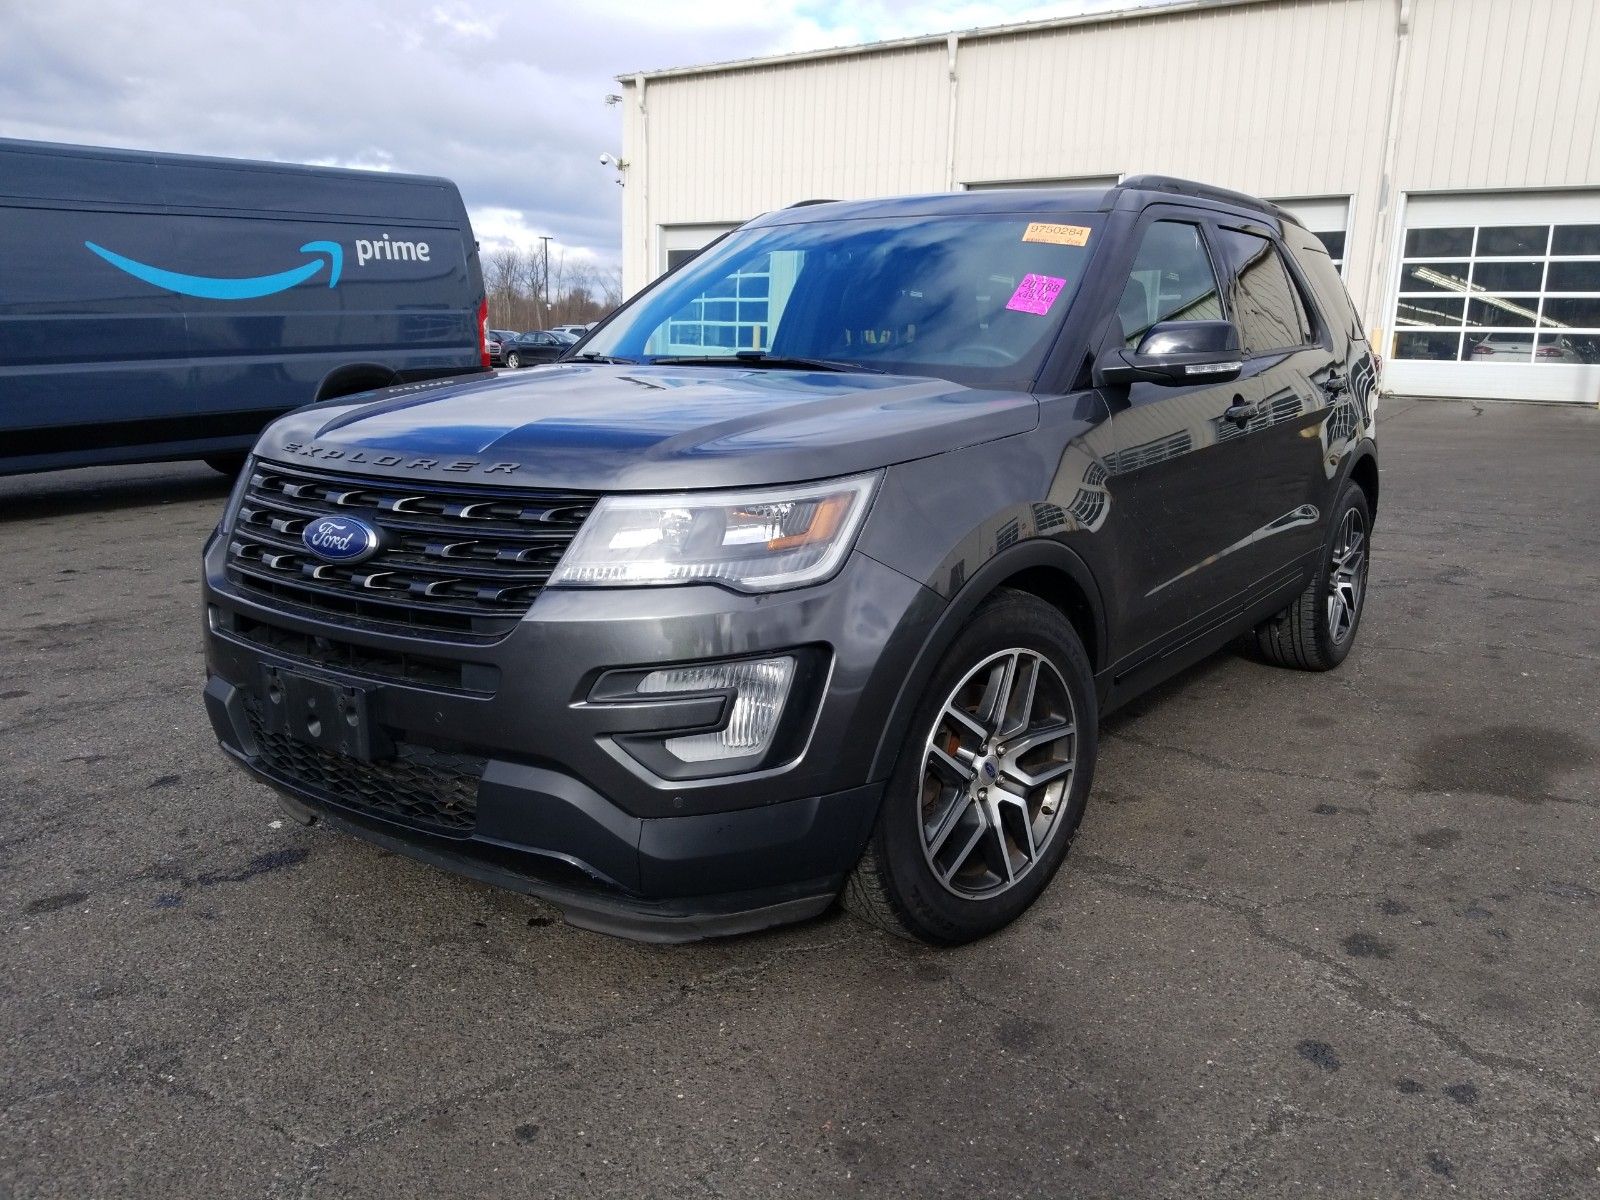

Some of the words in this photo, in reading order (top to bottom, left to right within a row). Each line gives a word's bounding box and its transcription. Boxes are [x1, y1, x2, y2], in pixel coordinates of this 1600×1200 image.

[355, 233, 431, 266] prime
[282, 441, 522, 474] EXPLORER
[312, 521, 354, 551] Ford
